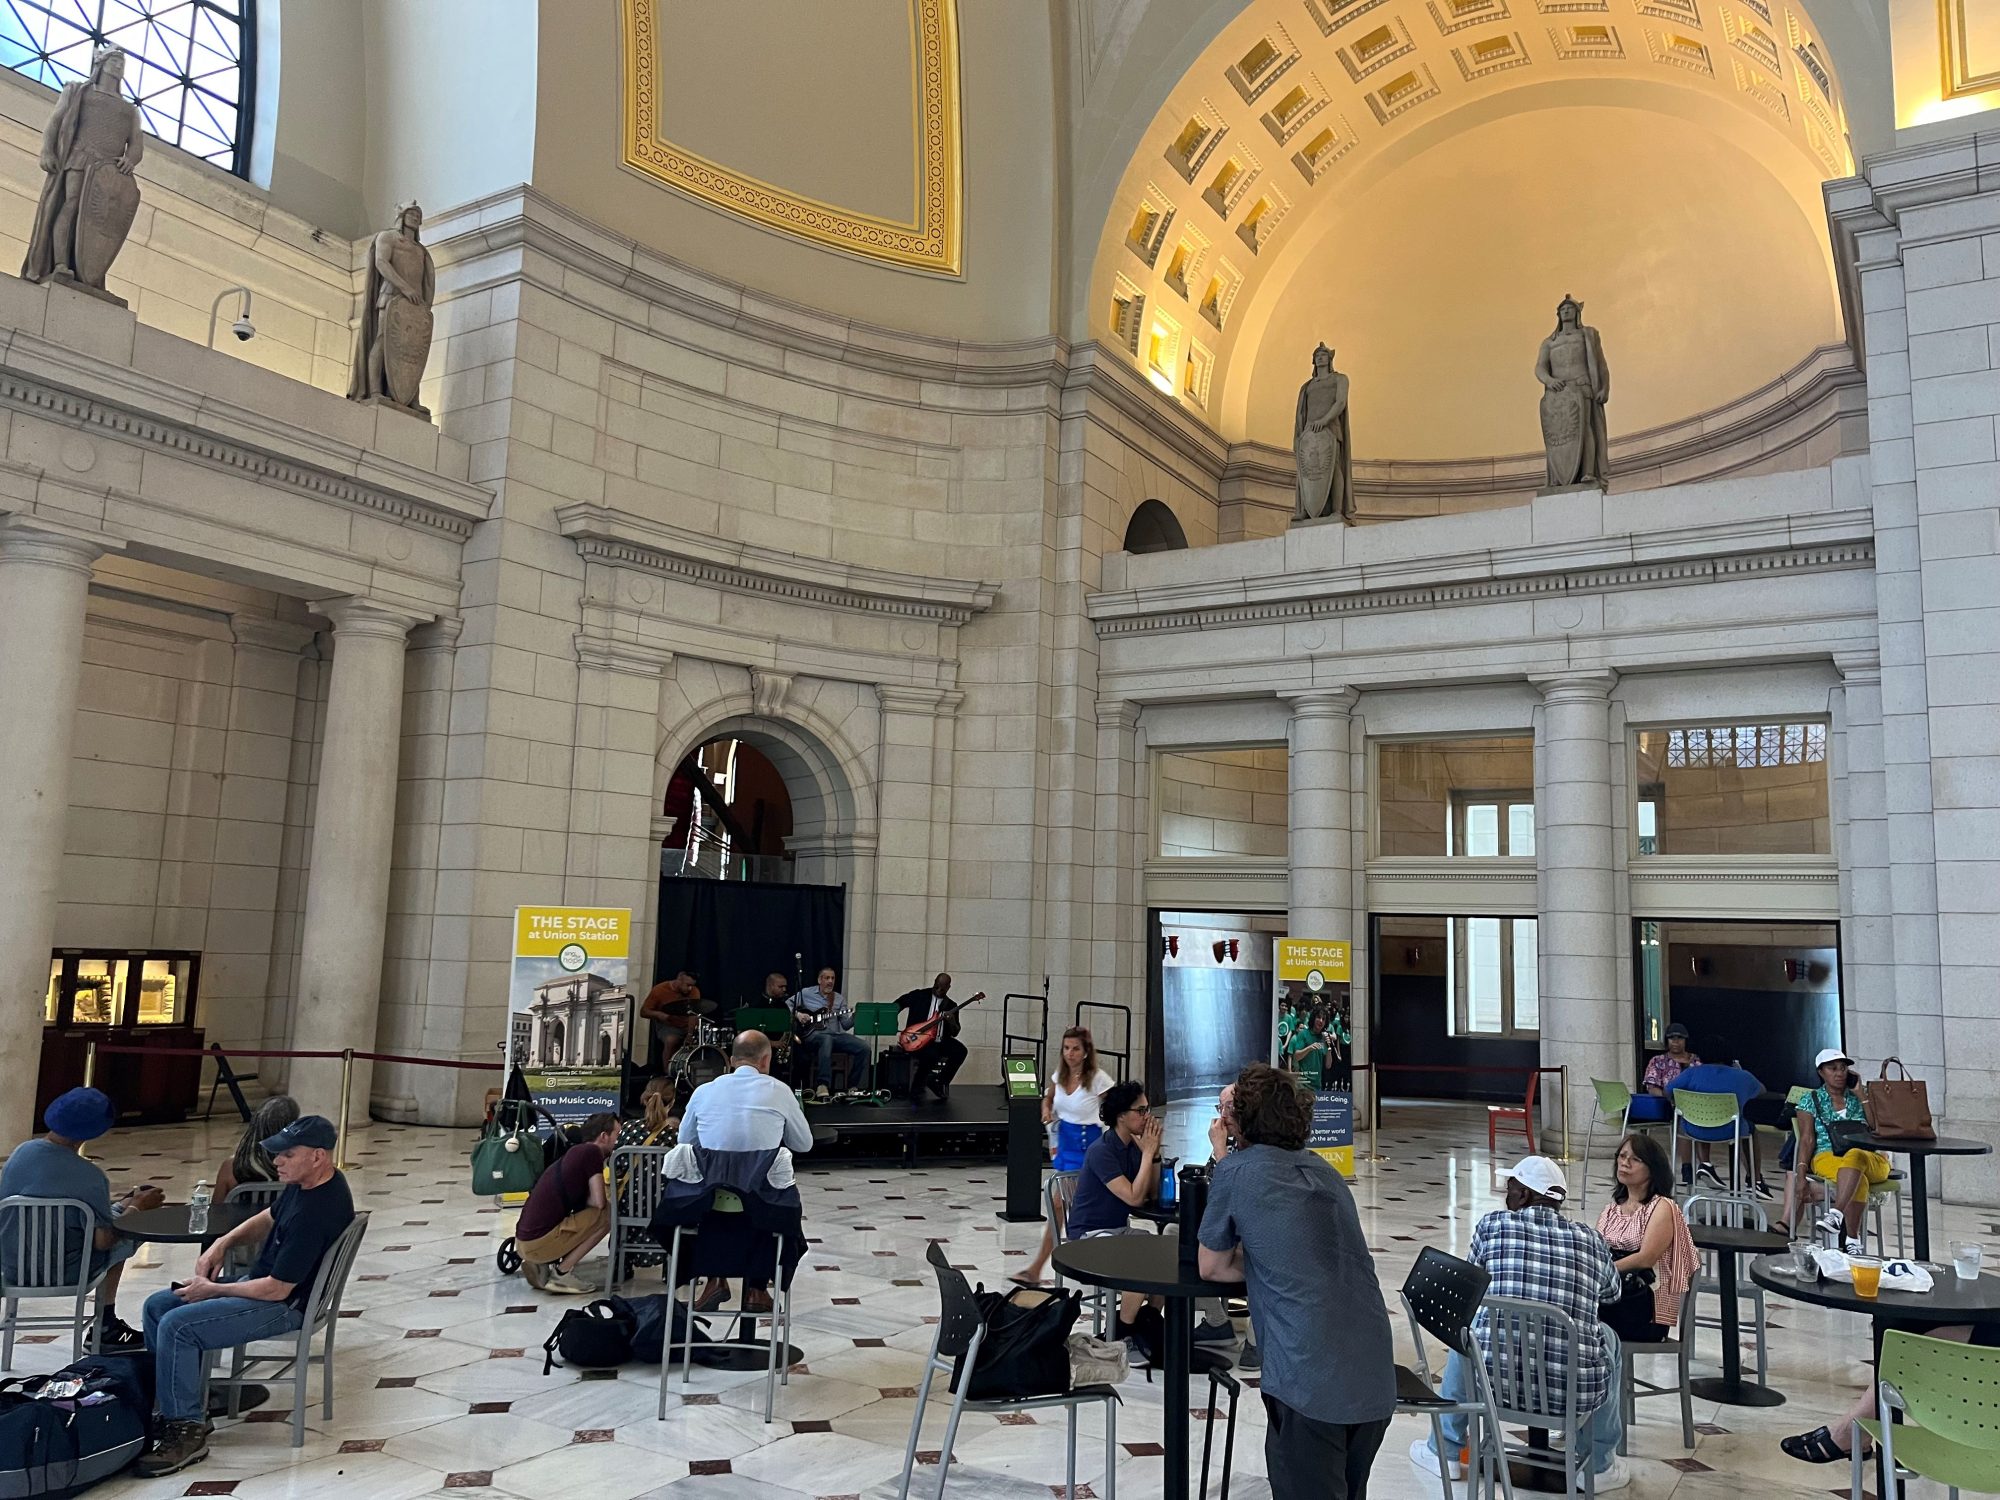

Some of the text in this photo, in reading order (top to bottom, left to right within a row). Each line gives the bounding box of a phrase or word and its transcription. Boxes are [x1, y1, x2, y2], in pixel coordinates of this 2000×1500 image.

[530, 915, 619, 929] THE STAGE
[543, 931, 576, 940] Union
[579, 931, 619, 941] Station
[1286, 946, 1343, 958] THE STAGE
[1318, 959, 1344, 967] Station
[539, 1097, 557, 1105] The
[559, 1096, 585, 1104] Music
[587, 1096, 615, 1107] Going.
